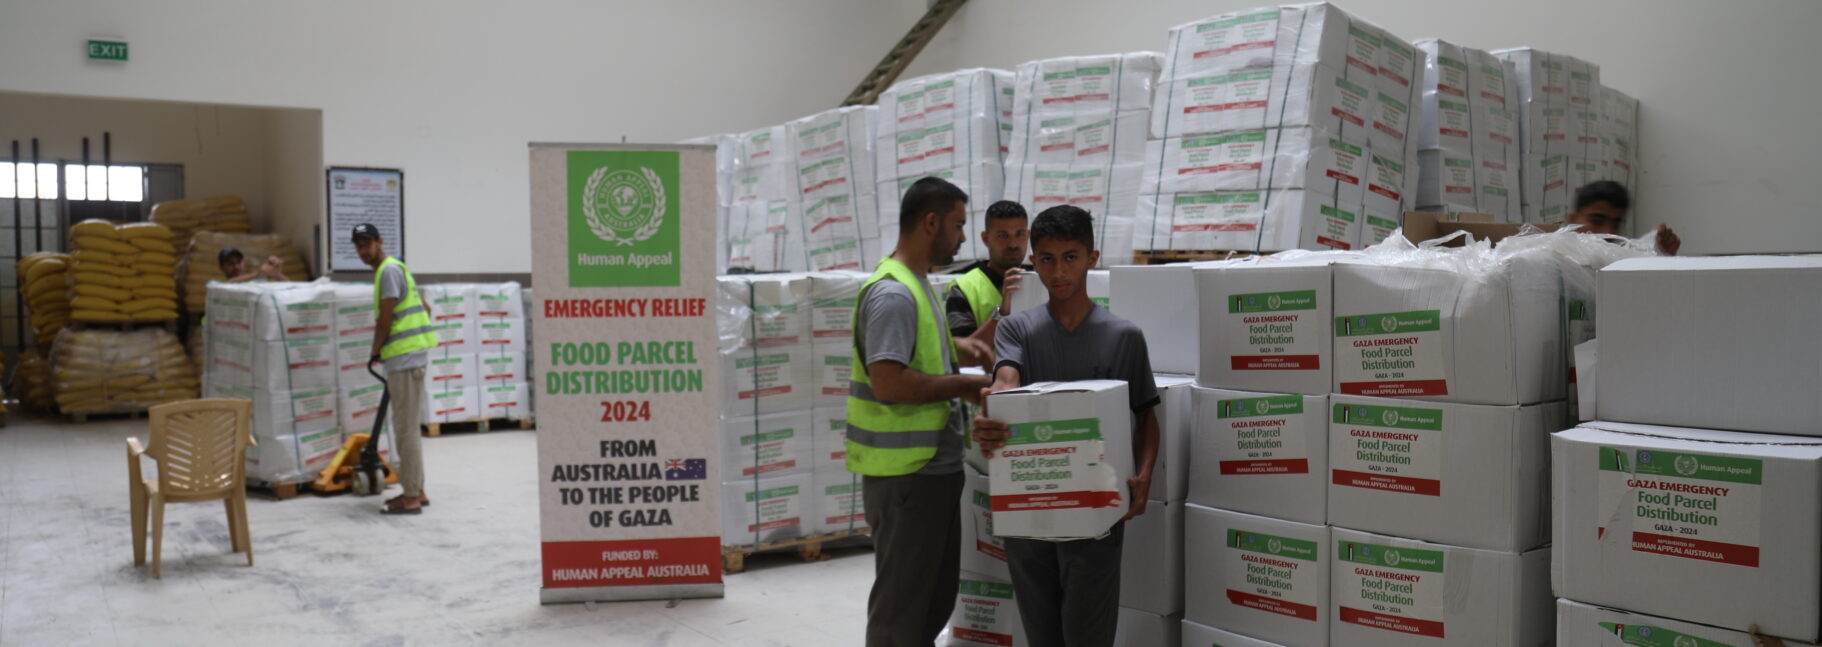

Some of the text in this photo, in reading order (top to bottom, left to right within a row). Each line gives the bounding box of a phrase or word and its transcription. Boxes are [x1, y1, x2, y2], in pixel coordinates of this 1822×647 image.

[90, 44, 126, 57] EXIT
[578, 251, 672, 268] Human Appeal
[544, 298, 706, 318] EMERGENCY RELIEF
[1261, 315, 1299, 323] EMERGENCY
[1250, 323, 1293, 334] Food Parcel
[1250, 334, 1294, 345] Distribution
[1353, 337, 1419, 348] GAZA EMERGENCY
[551, 341, 698, 366] FOOD PARCEL
[1361, 346, 1413, 359] Food Parcel
[1362, 359, 1415, 370] Distribution
[546, 369, 703, 395] DISTRIBUTION
[600, 400, 651, 422] 2024
[1249, 419, 1286, 427] EMERGENCY
[1237, 427, 1280, 439] Food Parcel
[1350, 429, 1419, 442] GAZA EMERGENCY
[600, 439, 657, 458] FROM
[1026, 446, 1077, 456] EMERGENCY
[1237, 439, 1282, 450] Distribution
[1357, 439, 1410, 453] Food Parcel
[1011, 455, 1070, 470] Food Parcel
[1357, 450, 1411, 465] Distribution
[551, 463, 662, 482] AUSTRALIA
[1011, 469, 1072, 482] Distribution
[1700, 464, 1752, 475] Human Appeal
[559, 484, 700, 505] TO THE PEOPLE
[1627, 479, 1729, 496] GAZA EMERGENCY
[1638, 491, 1717, 511] Food Parcel
[589, 508, 672, 528] OF GAZA
[1637, 505, 1718, 526] Distribution
[1654, 524, 1673, 533] GAZA
[1679, 527, 1698, 535] 2024
[602, 550, 659, 561] FUNDED BY:
[1657, 545, 1683, 554] APPEAL
[1684, 548, 1724, 560] AUSTRALIA
[1241, 554, 1299, 569] GAZA EMERGENCY
[552, 564, 710, 581] HUMAN APPEAL AUSTRALIA
[1247, 563, 1291, 579] Food Parcel
[1354, 567, 1421, 583] GAZA EMERGENCY
[1246, 574, 1292, 591] Distribution
[1361, 577, 1413, 594] Food Parcel
[1361, 588, 1414, 606] Distribution
